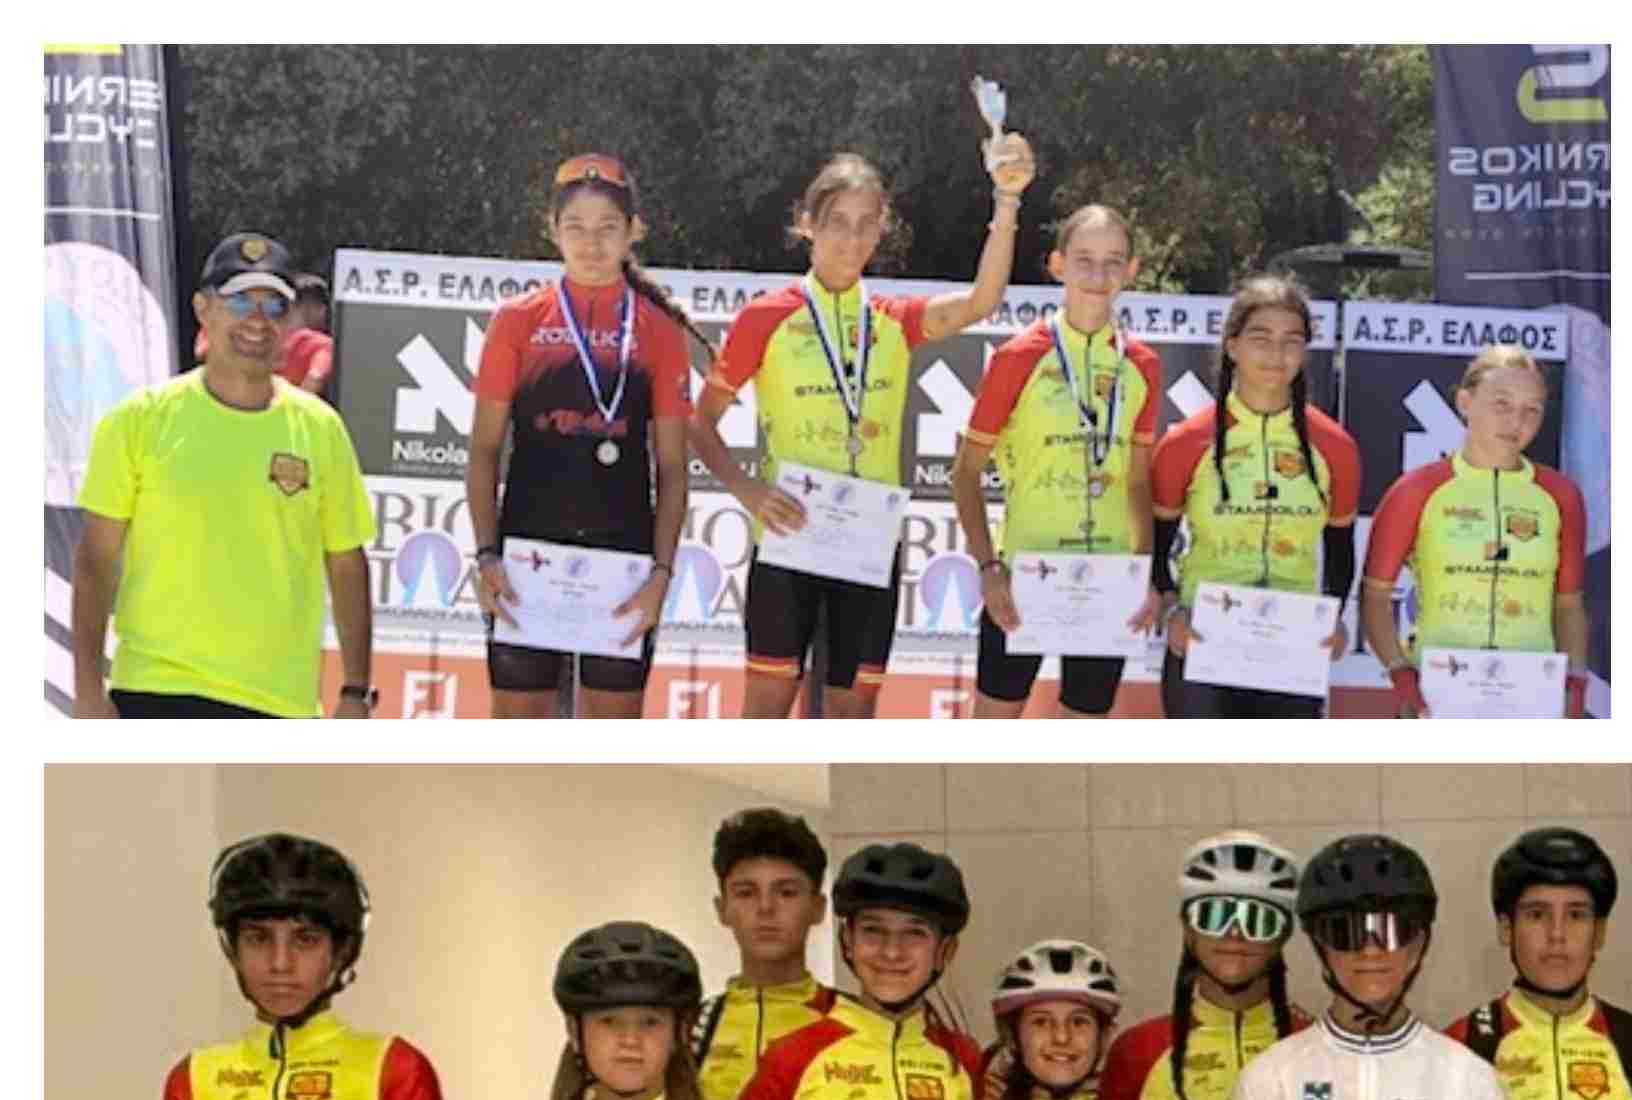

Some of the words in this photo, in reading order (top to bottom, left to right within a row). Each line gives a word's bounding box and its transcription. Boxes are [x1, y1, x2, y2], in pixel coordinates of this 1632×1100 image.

[438, 272, 550, 303] ΕΛΑΦΟ
[1353, 316, 1432, 345] Α.Σ.Ρ.
[1442, 320, 1557, 351] ΕΛΑΦΟΣ
[393, 439, 470, 466] Nikola
